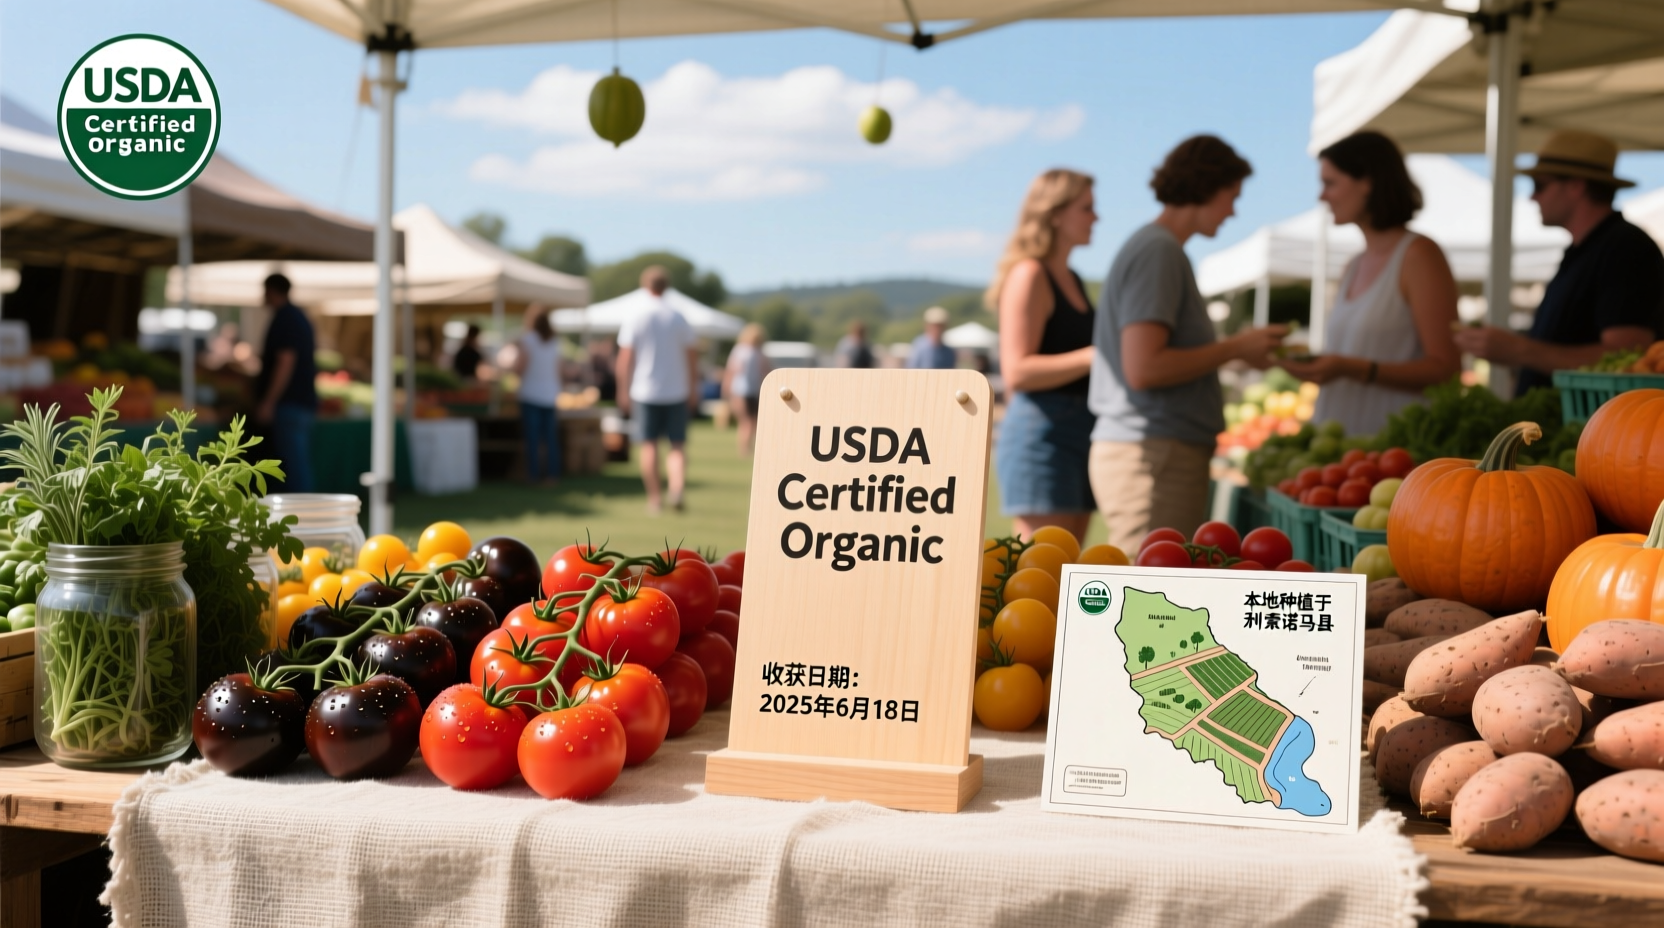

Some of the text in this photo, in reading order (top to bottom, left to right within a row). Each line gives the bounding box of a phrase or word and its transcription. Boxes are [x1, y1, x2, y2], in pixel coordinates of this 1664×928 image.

[811, 425, 931, 465] USDA
[777, 472, 957, 515] Certified
[780, 521, 944, 572] Organic
[1243, 590, 1332, 612] 本地种植于
[761, 661, 859, 690] 收获日期：
[759, 693, 919, 723] 2025年6月18日
